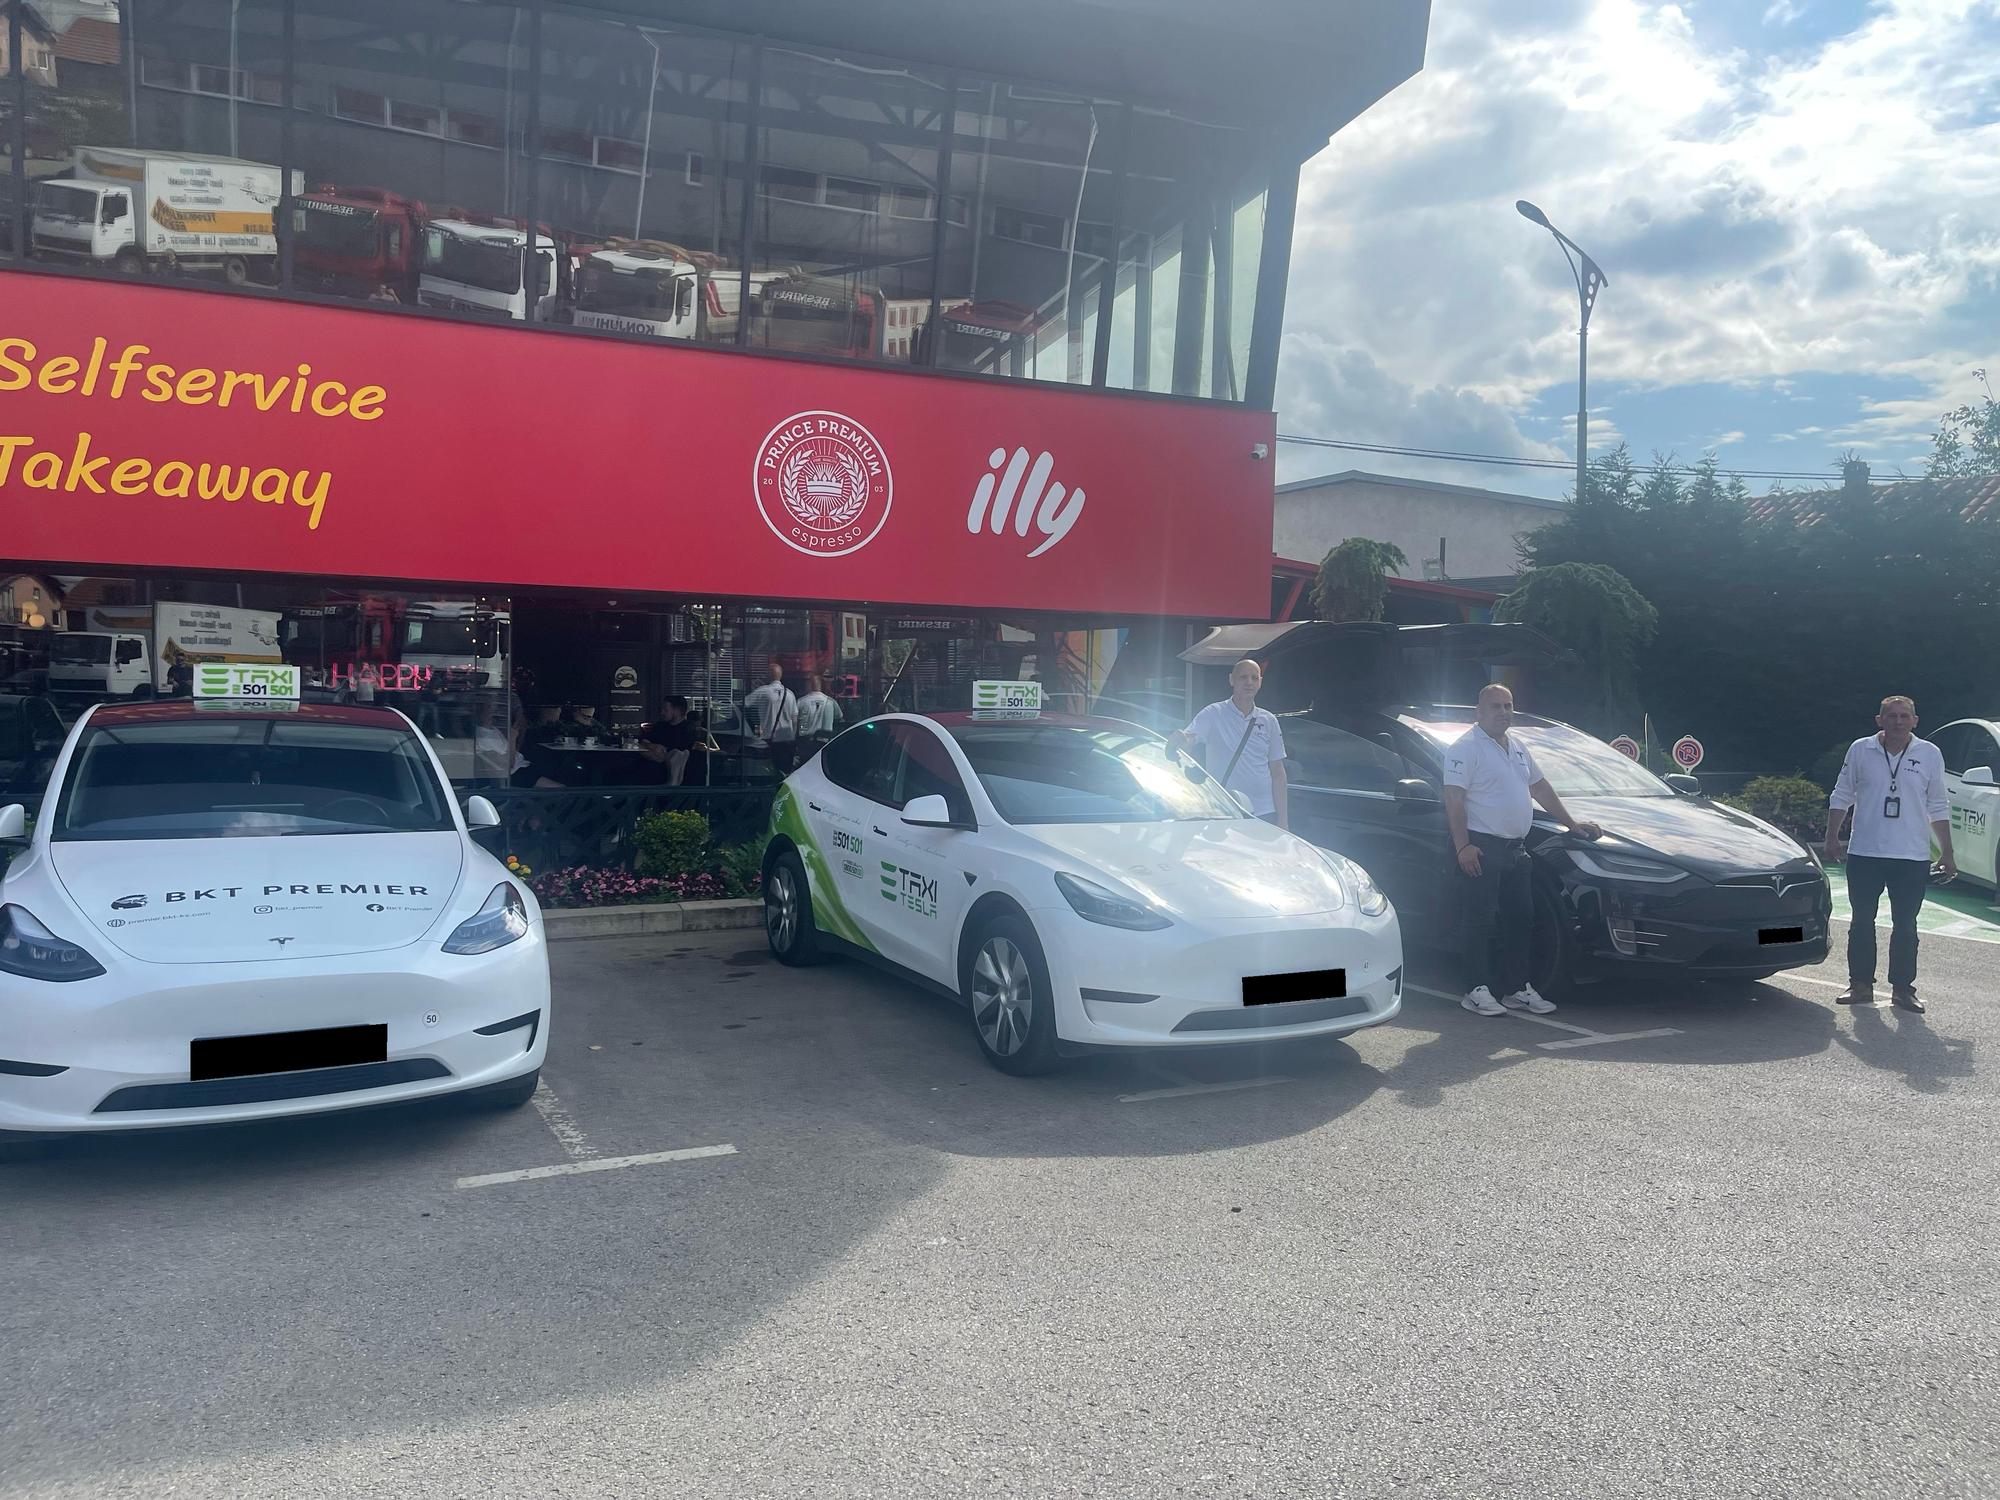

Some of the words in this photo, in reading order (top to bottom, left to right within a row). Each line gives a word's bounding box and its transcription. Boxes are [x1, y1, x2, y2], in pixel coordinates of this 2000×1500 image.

[0, 336, 387, 420] Selfservice
[764, 420, 814, 469] PRINCE
[818, 419, 882, 477] PREMIUM
[0, 432, 332, 530] Takeaway
[967, 446, 1086, 558] illy
[791, 526, 862, 548] espresso
[233, 669, 293, 684] TAXI
[331, 662, 433, 690] HAPPY
[243, 684, 267, 695] 501
[270, 685, 293, 696] 501
[1001, 685, 1039, 697] TAXI
[1007, 697, 1023, 707] 501
[1024, 698, 1038, 707] 501
[1963, 808, 1986, 827] TAXI
[837, 831, 850, 850] 501
[850, 836, 863, 855] 501
[165, 887, 243, 903] BKT
[263, 883, 429, 896] PREMIER
[899, 867, 938, 903] TAXI
[900, 891, 938, 920] TESLA
[426, 1014, 437, 1024] 50
